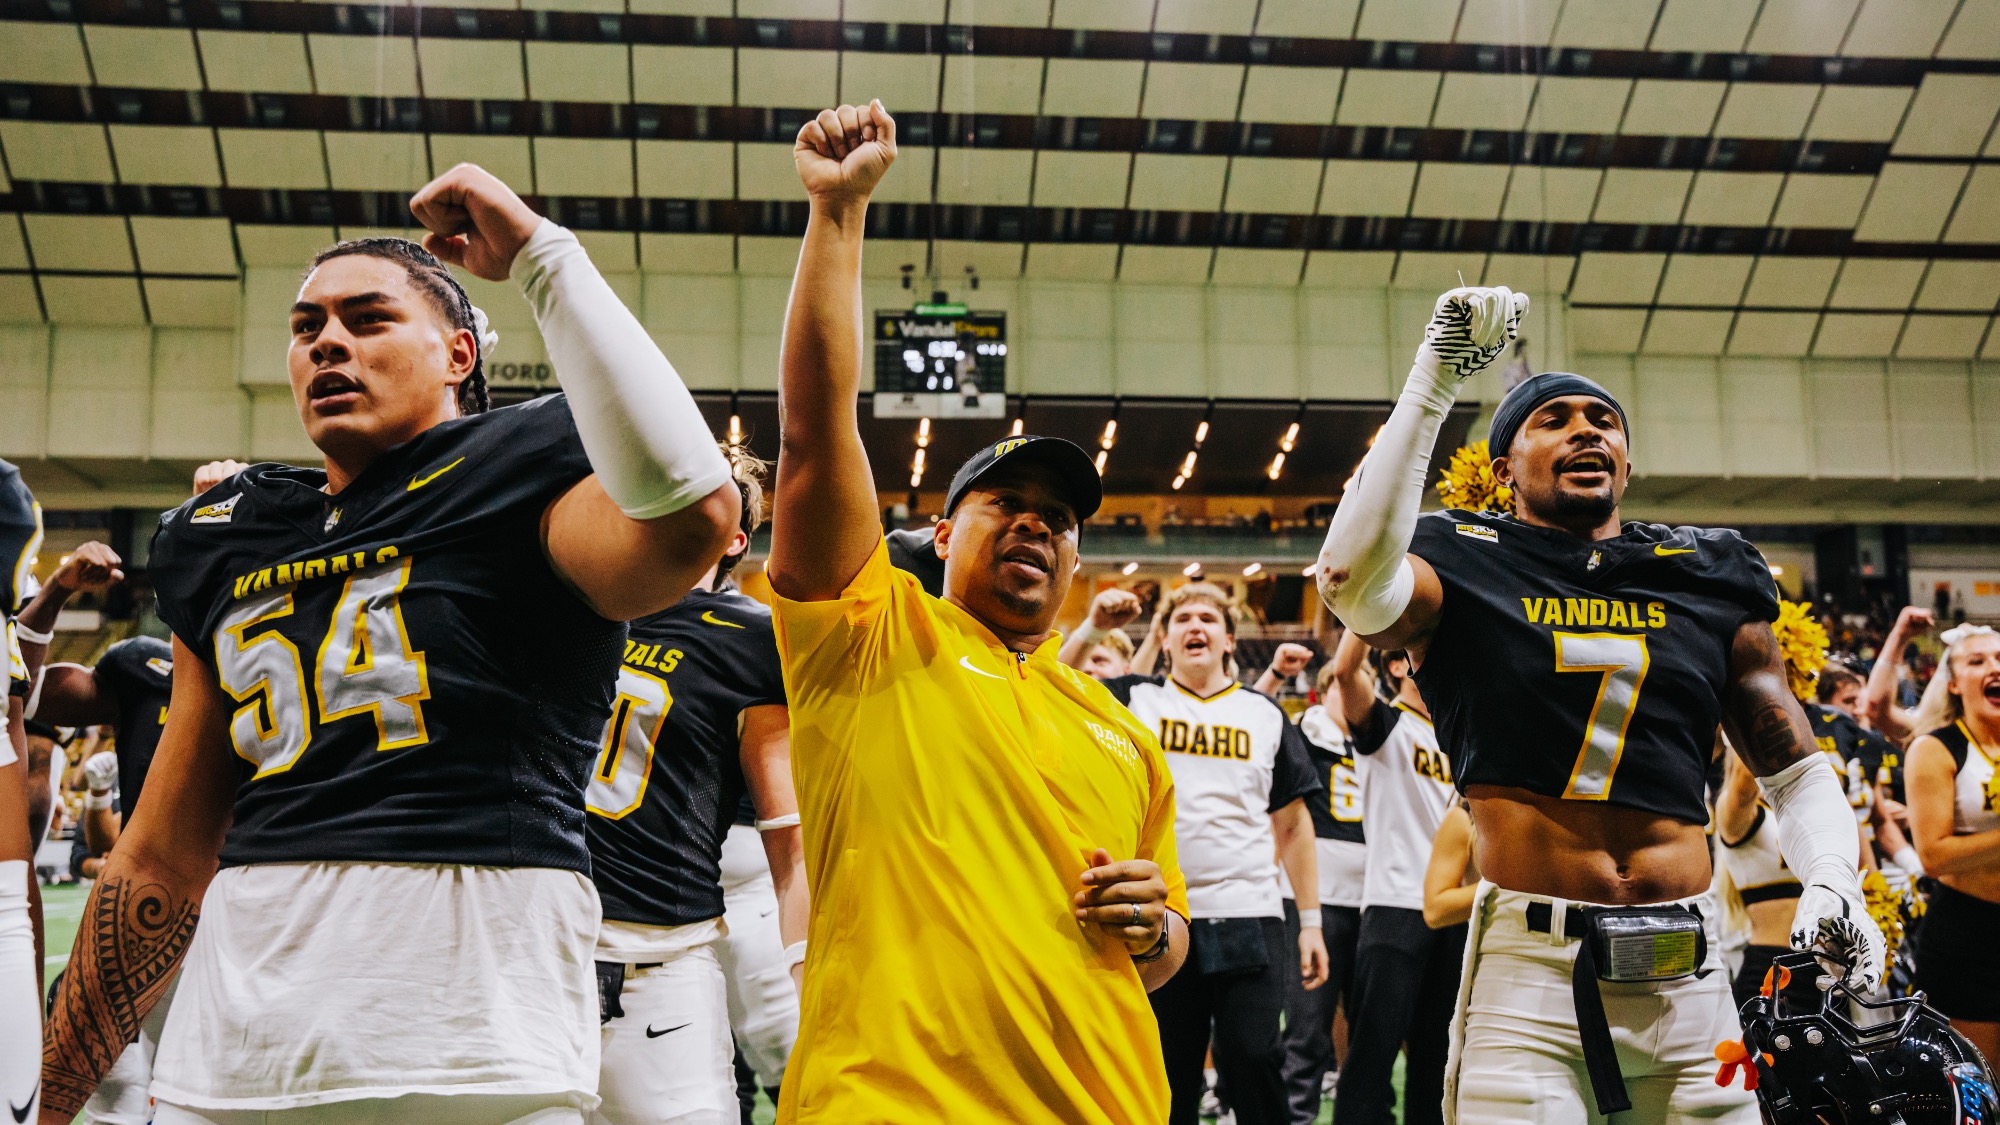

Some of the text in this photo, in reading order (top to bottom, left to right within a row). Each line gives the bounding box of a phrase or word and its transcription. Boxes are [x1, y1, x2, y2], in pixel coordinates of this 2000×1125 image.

[1521, 597, 1667, 629] VANDALS
[214, 555, 431, 781] 54
[1552, 630, 1650, 801] 7
[1084, 720, 1137, 760] IDAHO
[1160, 717, 1251, 761] IDAHO
